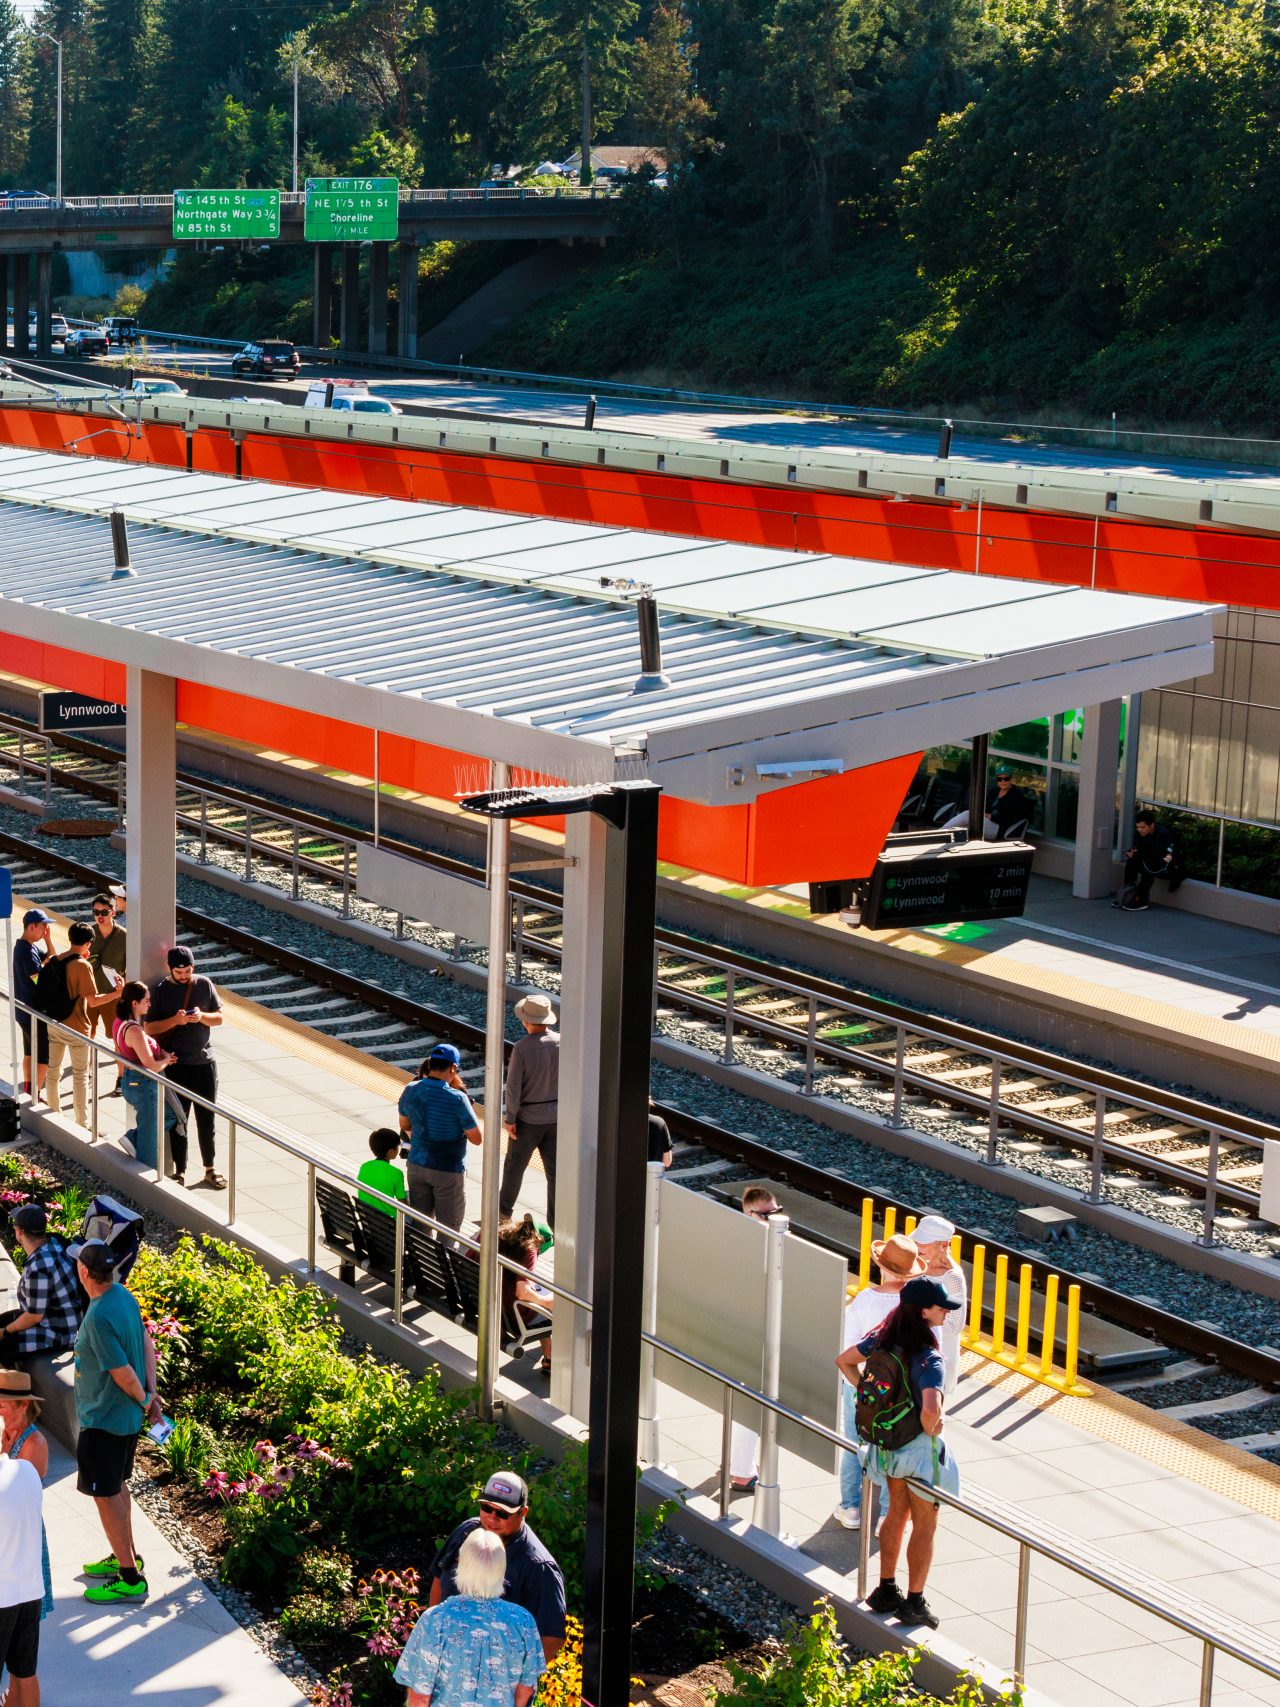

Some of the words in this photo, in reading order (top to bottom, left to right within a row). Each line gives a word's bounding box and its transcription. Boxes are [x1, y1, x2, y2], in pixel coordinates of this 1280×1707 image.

[332, 181, 350, 189] EXIT
[354, 180, 373, 190] 176
[177, 196, 192, 205] NE
[234, 196, 246, 205] St
[269, 195, 276, 205] 2
[314, 199, 330, 208] NE
[377, 198, 389, 208] St
[176, 209, 228, 221] Northgate
[232, 209, 253, 221] Way
[330, 213, 374, 223] Shoreline
[176, 224, 184, 233] N
[220, 223, 232, 233] St
[269, 223, 276, 232] 5
[59, 702, 117, 720] Lynnwood
[896, 872, 949, 889] Lynnwood
[997, 868, 1004, 878] 2
[1006, 867, 1026, 877] min
[894, 893, 945, 910] Lynnwood
[989, 888, 1000, 899] 10
[1002, 887, 1022, 897] min
